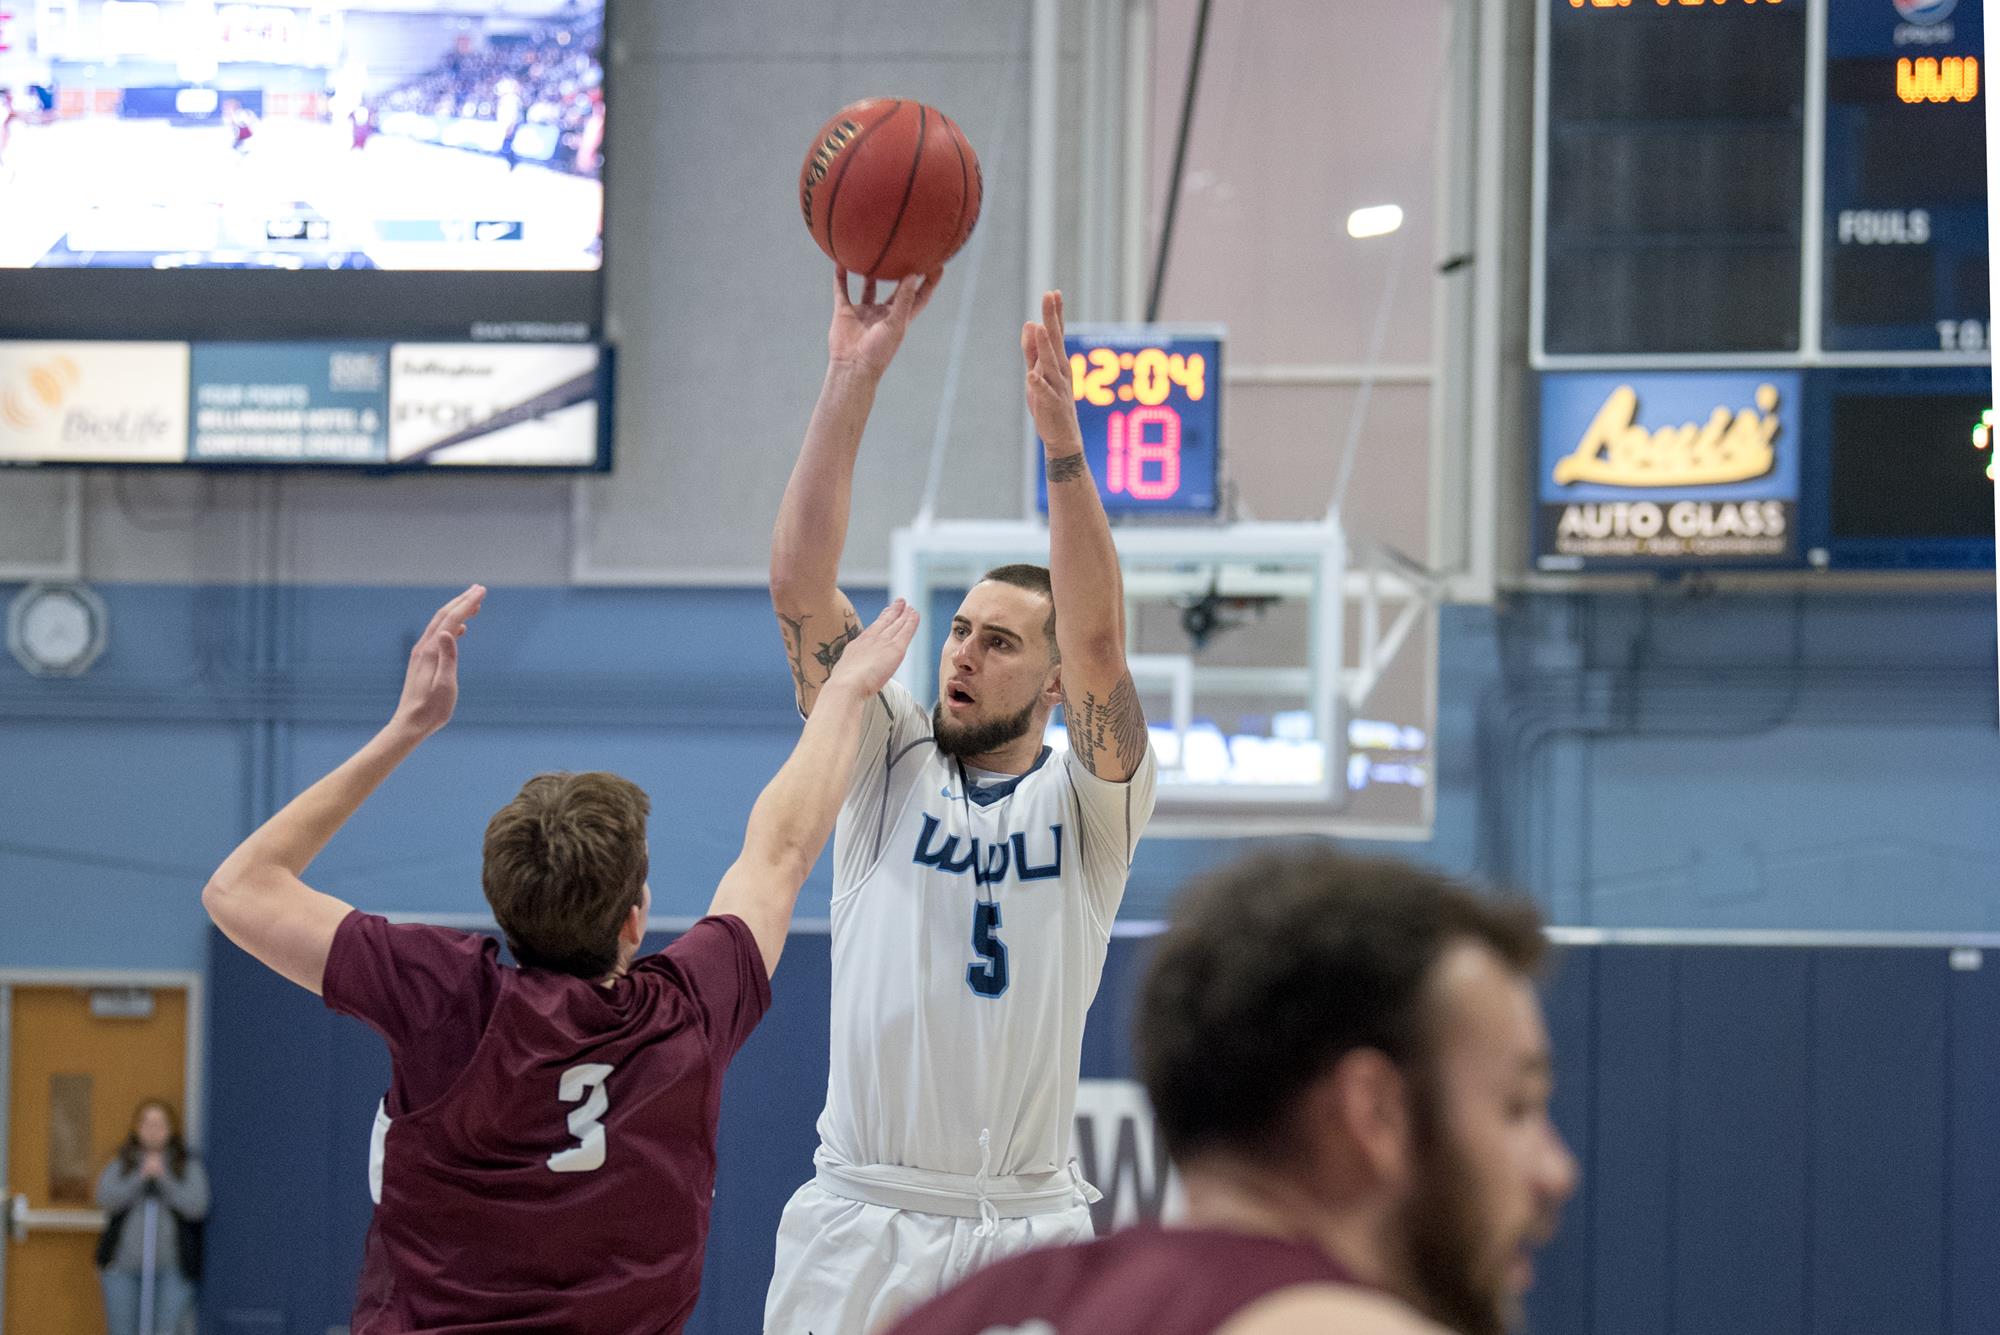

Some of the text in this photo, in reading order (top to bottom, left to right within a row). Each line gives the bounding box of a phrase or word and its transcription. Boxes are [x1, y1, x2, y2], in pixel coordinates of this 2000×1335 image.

[1838, 210, 1930, 244] FOULS
[1070, 349, 1205, 406] 12:04
[1107, 405, 1181, 500] 18
[1558, 501, 1786, 538] AUTO GLASS
[965, 899, 1010, 999] 5
[546, 1063, 615, 1172] 3
